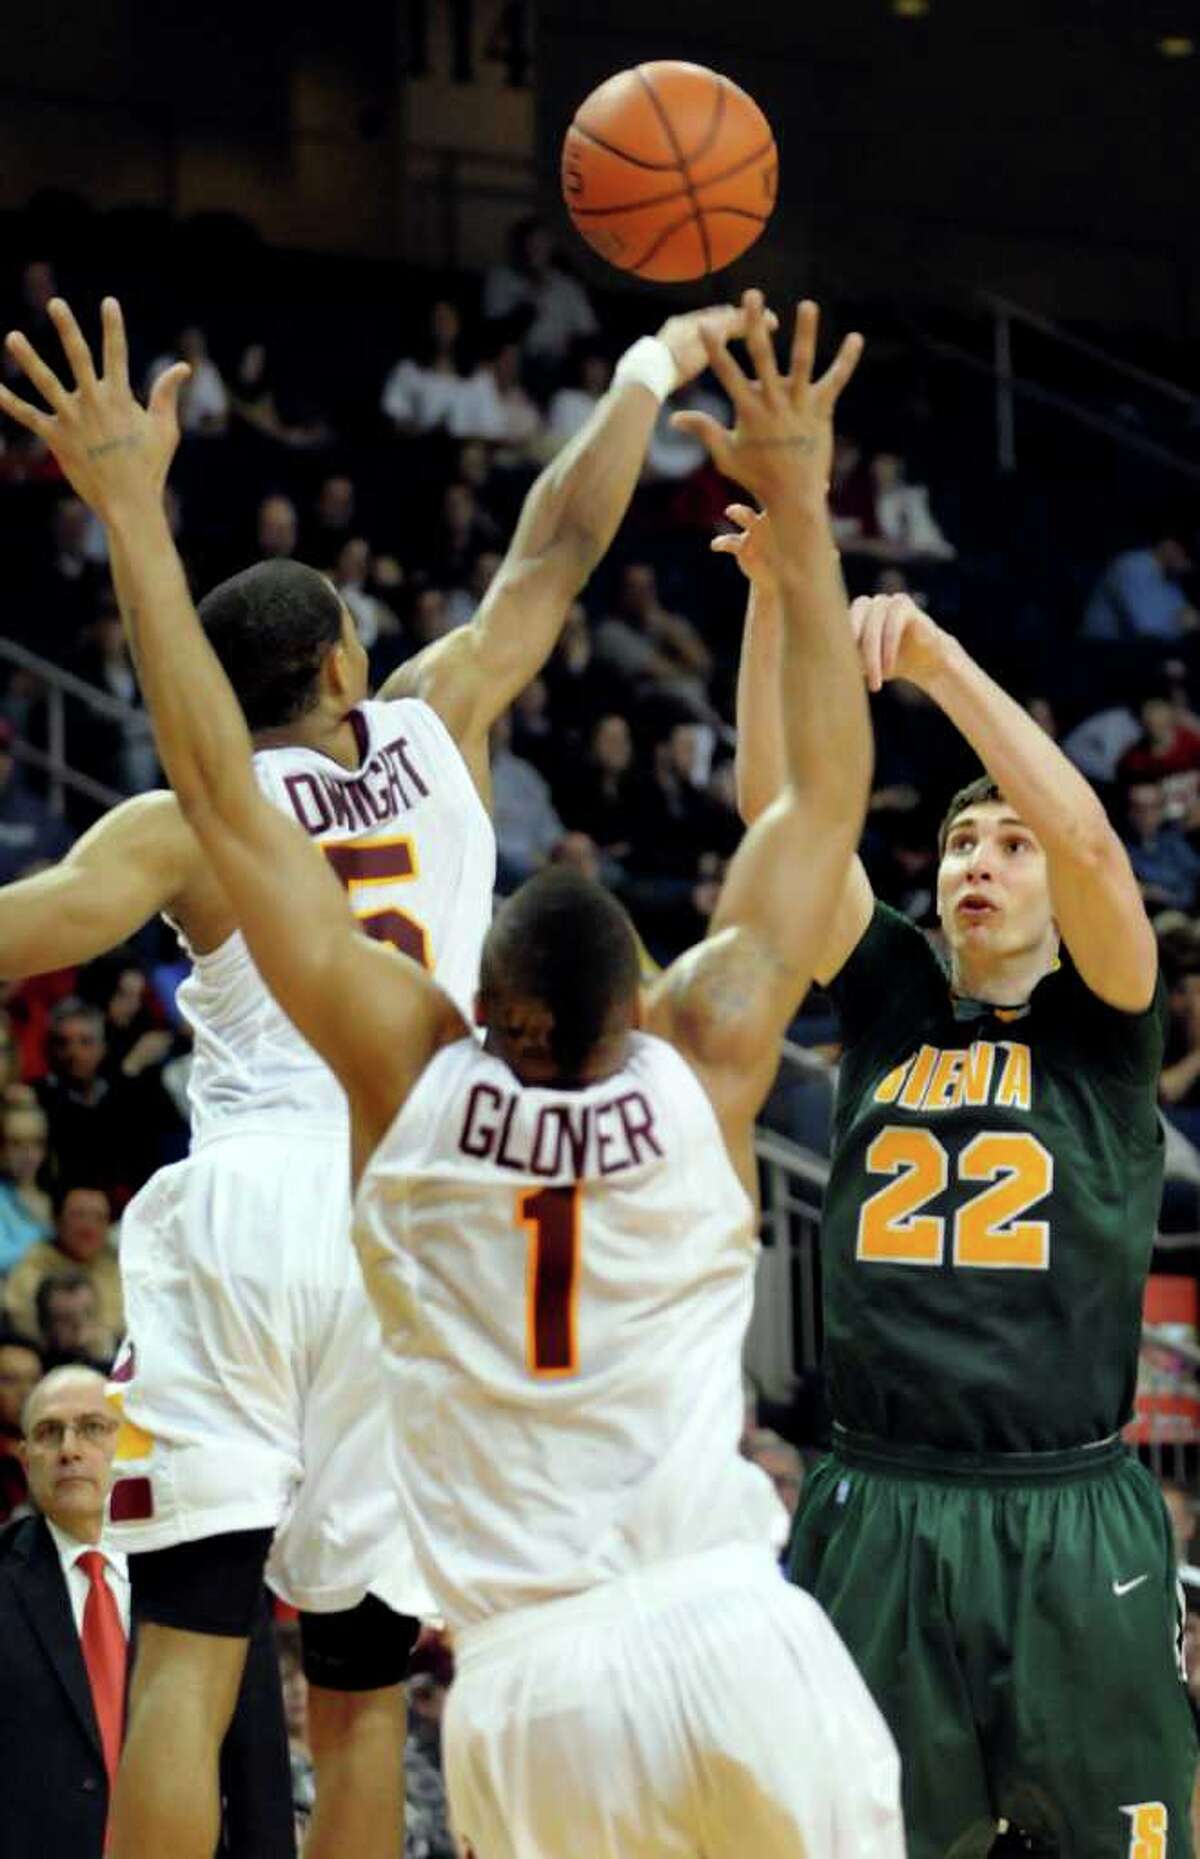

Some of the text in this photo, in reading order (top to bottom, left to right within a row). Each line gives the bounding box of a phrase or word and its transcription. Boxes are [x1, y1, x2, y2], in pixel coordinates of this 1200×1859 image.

[283, 736, 430, 837] DWIGHT
[458, 1082, 666, 1180] GLOVER
[856, 1124, 1054, 1271] 22
[513, 1184, 585, 1379] 1
